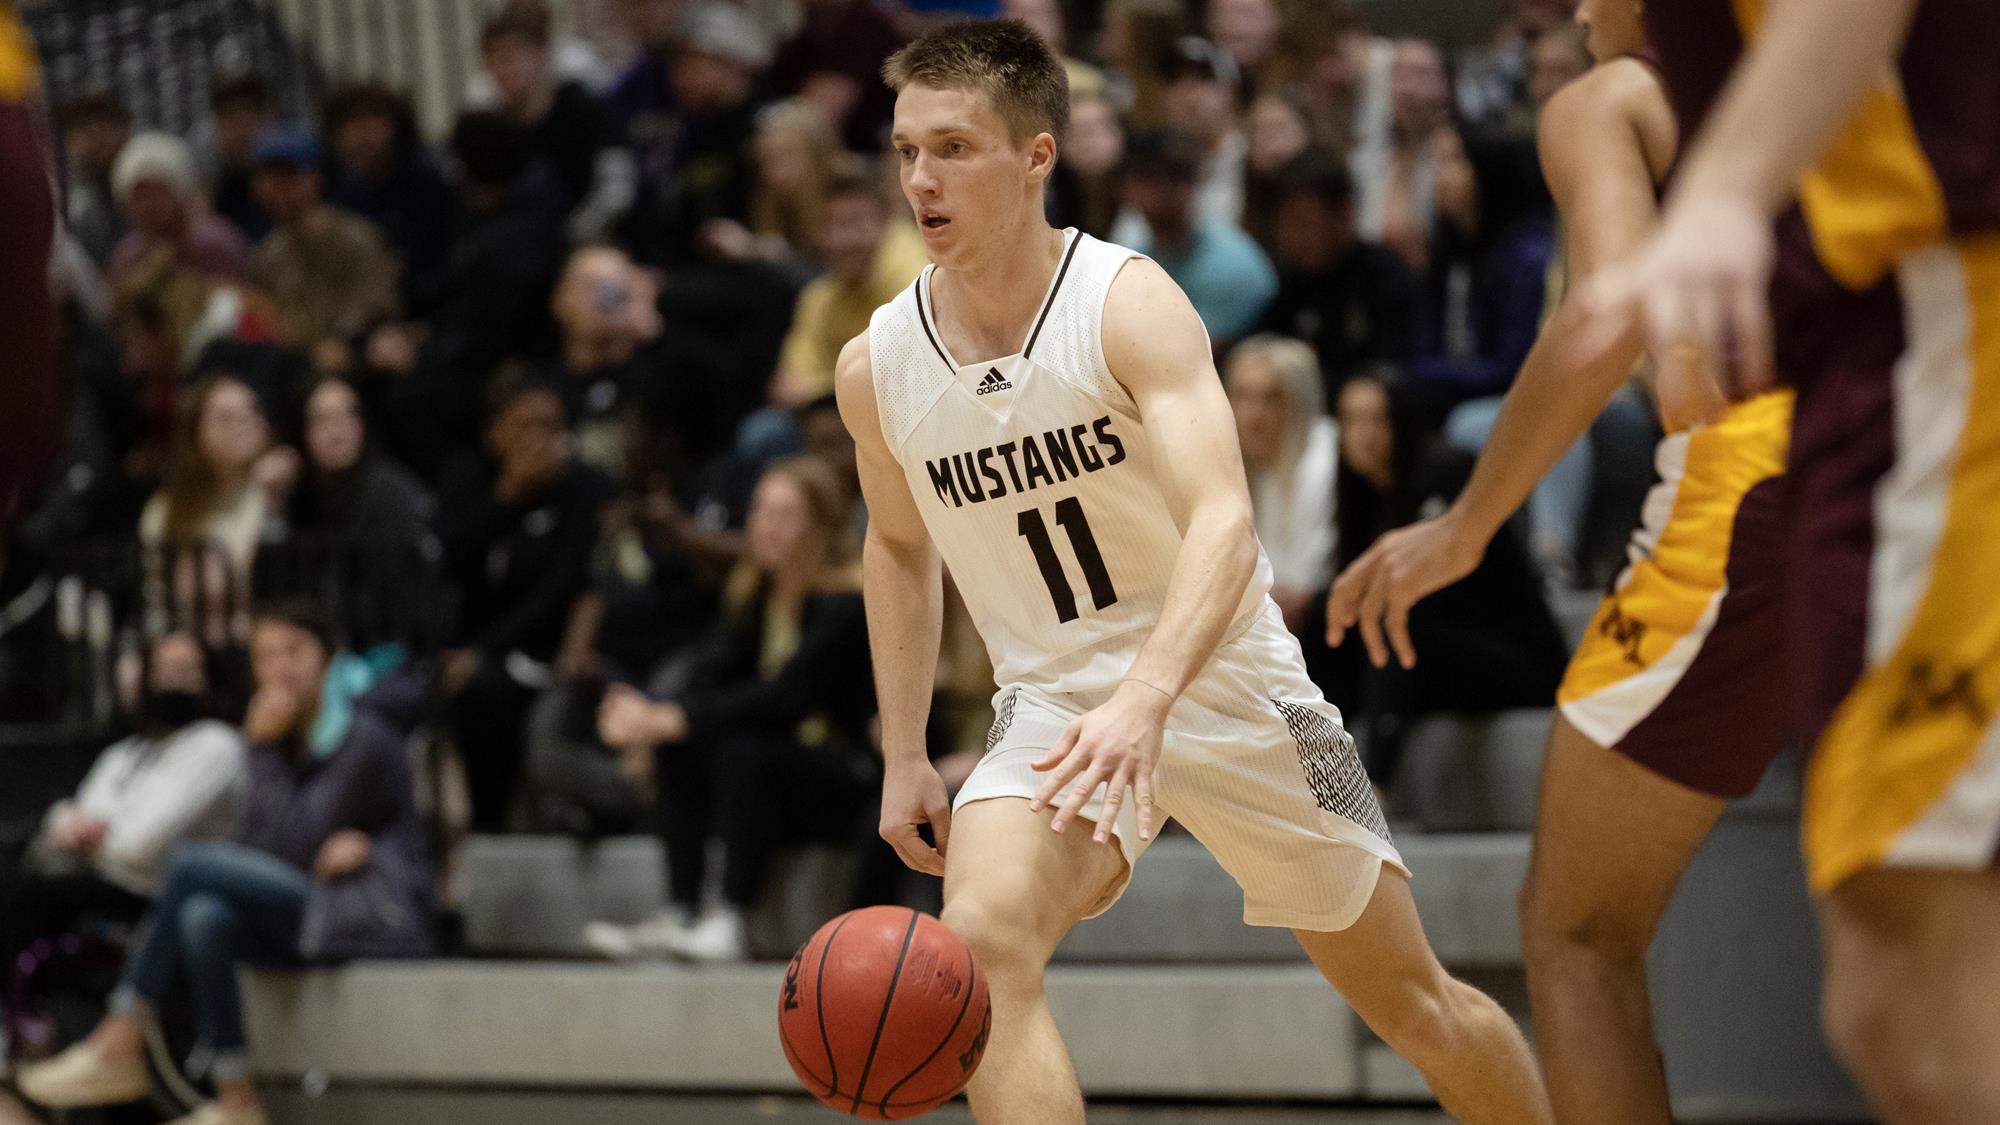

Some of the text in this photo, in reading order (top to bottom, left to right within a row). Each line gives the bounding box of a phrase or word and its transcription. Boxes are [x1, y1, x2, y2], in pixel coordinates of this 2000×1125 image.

[976, 380, 1013, 396] adidas
[925, 415, 1127, 509] MUSTANGS
[1017, 496, 1118, 624] 11
